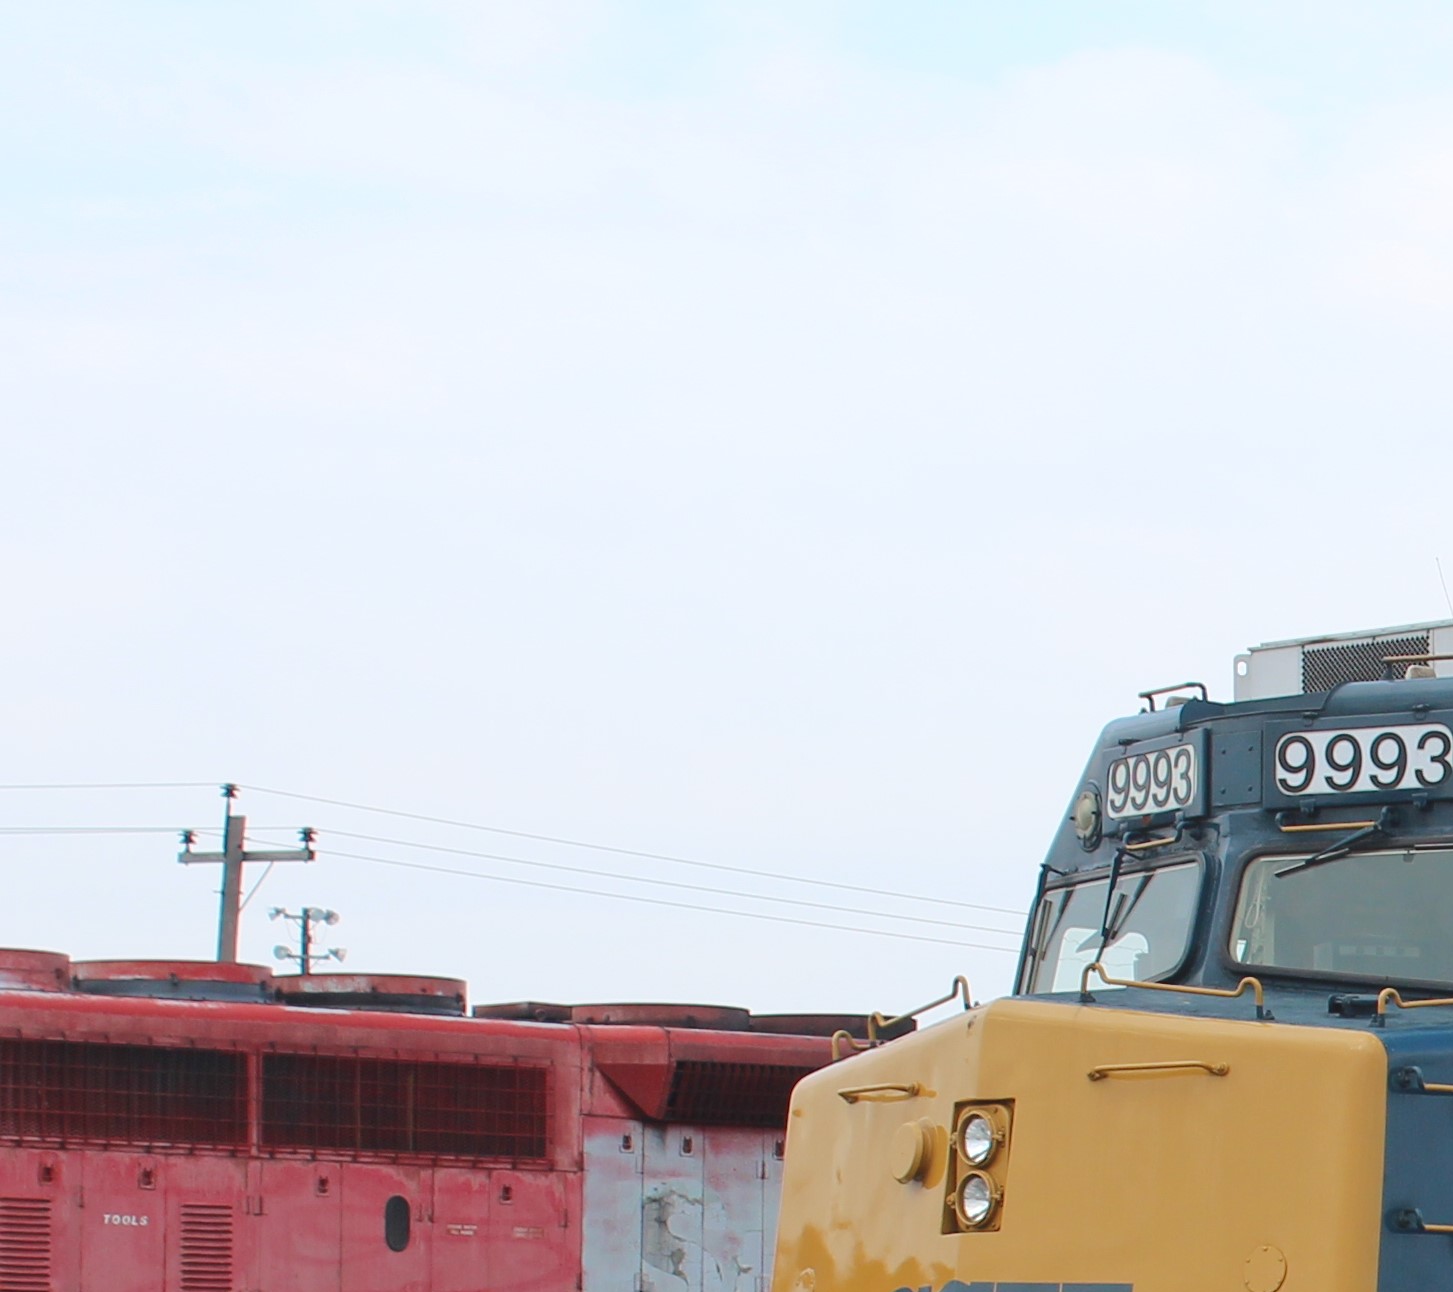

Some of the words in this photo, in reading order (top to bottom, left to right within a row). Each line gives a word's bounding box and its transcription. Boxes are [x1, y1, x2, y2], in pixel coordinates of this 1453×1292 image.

[1110, 748, 1192, 814] 9993
[1277, 730, 1452, 794] 9993
[103, 1214, 150, 1226] TOOLS
